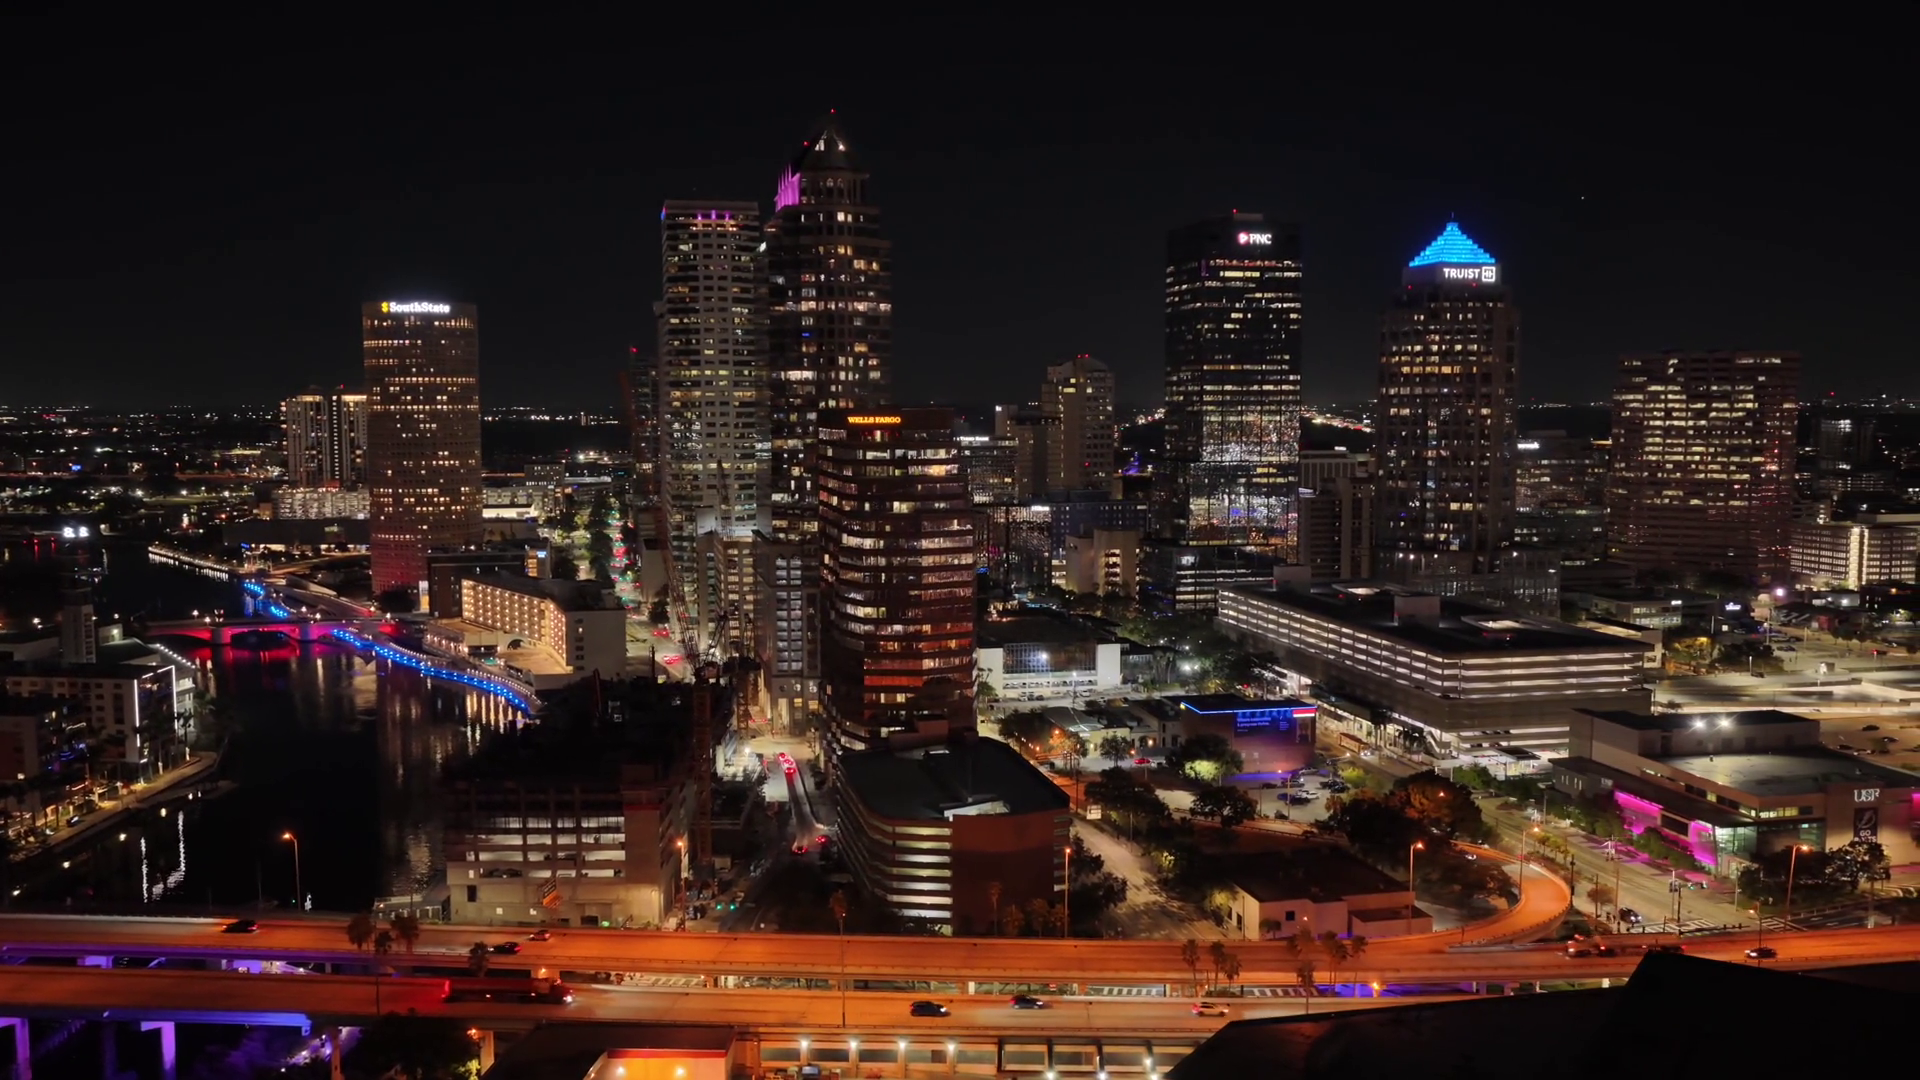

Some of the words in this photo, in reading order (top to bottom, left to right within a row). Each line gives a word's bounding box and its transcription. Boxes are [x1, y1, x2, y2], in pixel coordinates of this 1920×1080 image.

[1249, 233, 1272, 245] PNC
[1443, 268, 1481, 279] TRUIST
[389, 302, 450, 313] SouthState
[847, 416, 874, 424] WELLS
[875, 416, 901, 424] FARGO
[1854, 788, 1880, 802] USF
[1859, 829, 1872, 837] GO
